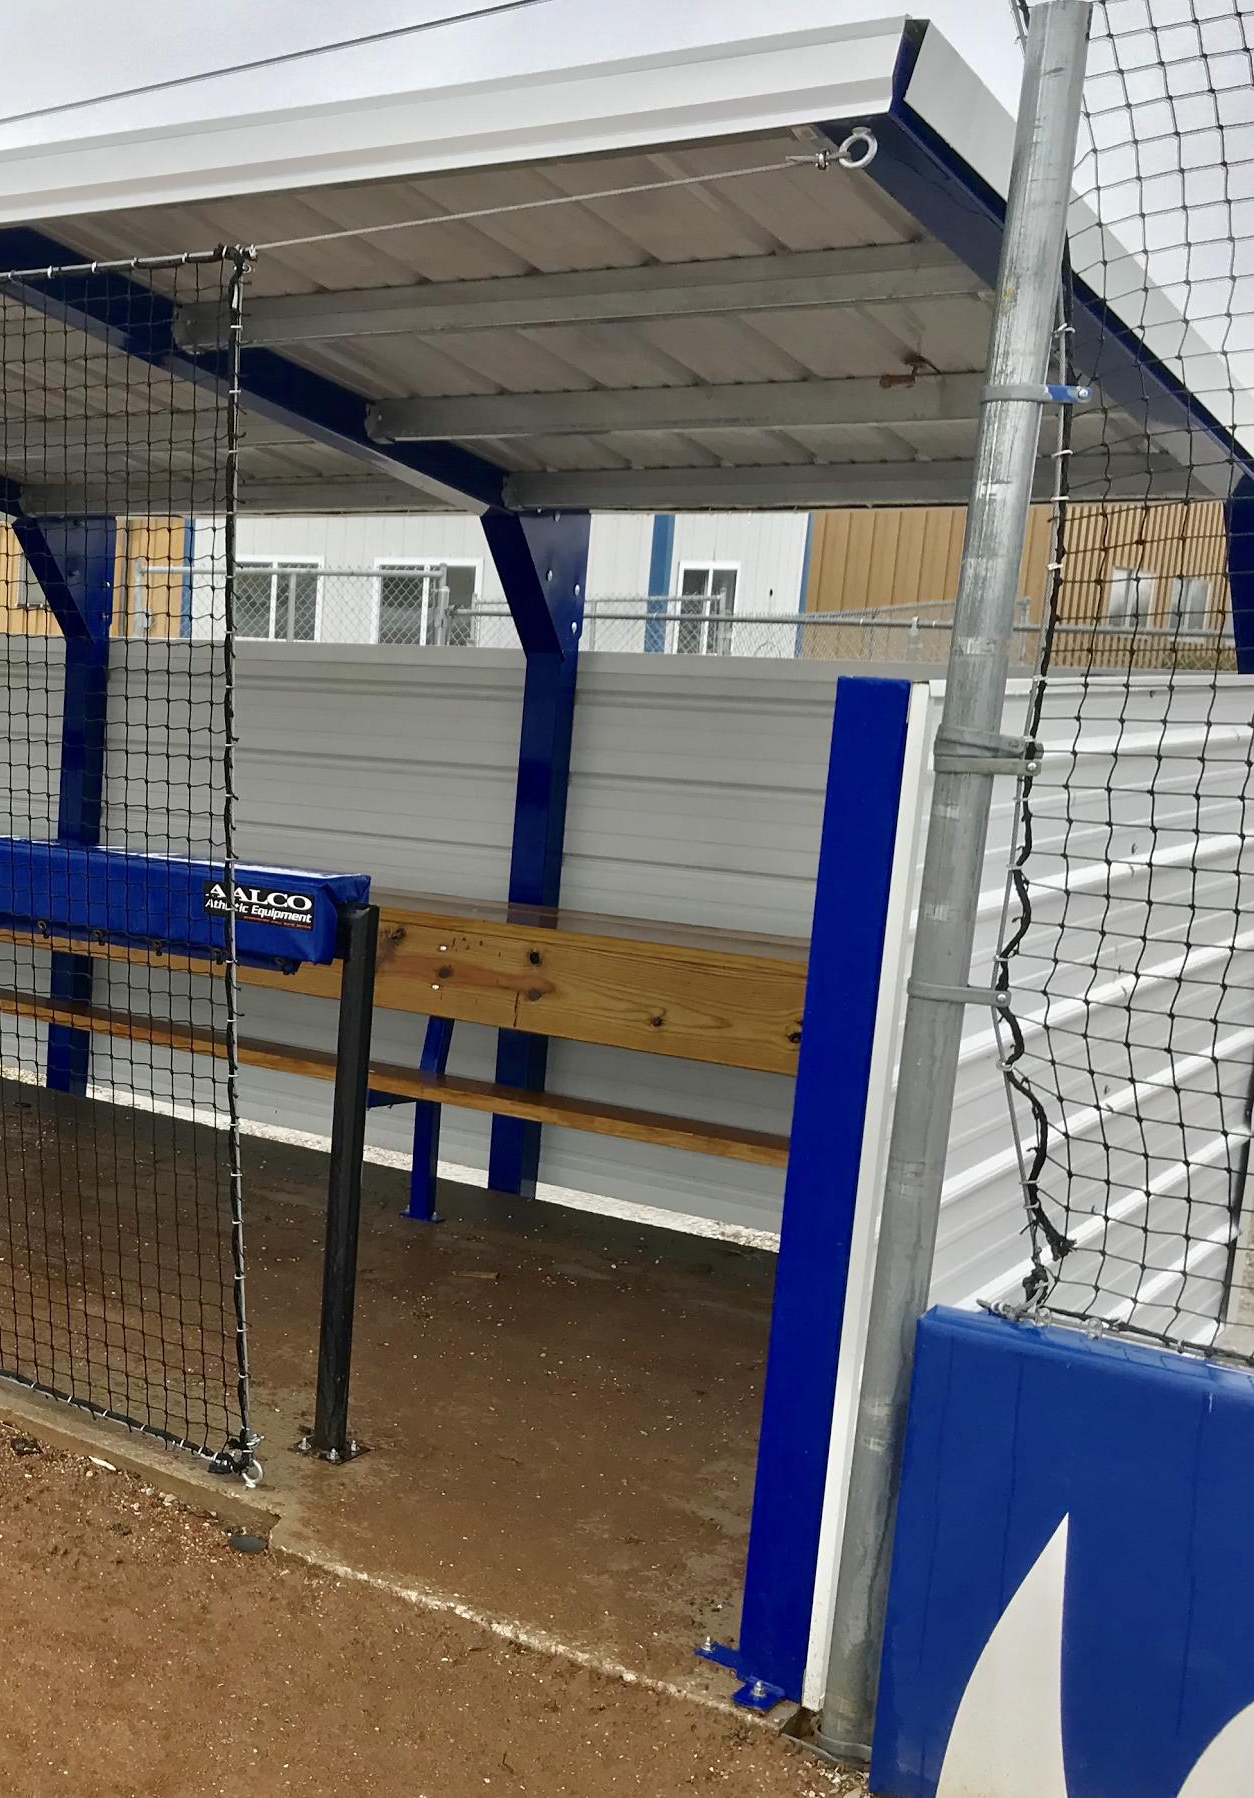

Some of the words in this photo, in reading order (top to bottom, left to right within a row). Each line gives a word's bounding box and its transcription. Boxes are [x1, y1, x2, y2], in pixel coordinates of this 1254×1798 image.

[205, 884, 312, 910] AALCO
[205, 898, 249, 914] Athtic
[251, 905, 312, 923] Equipment
